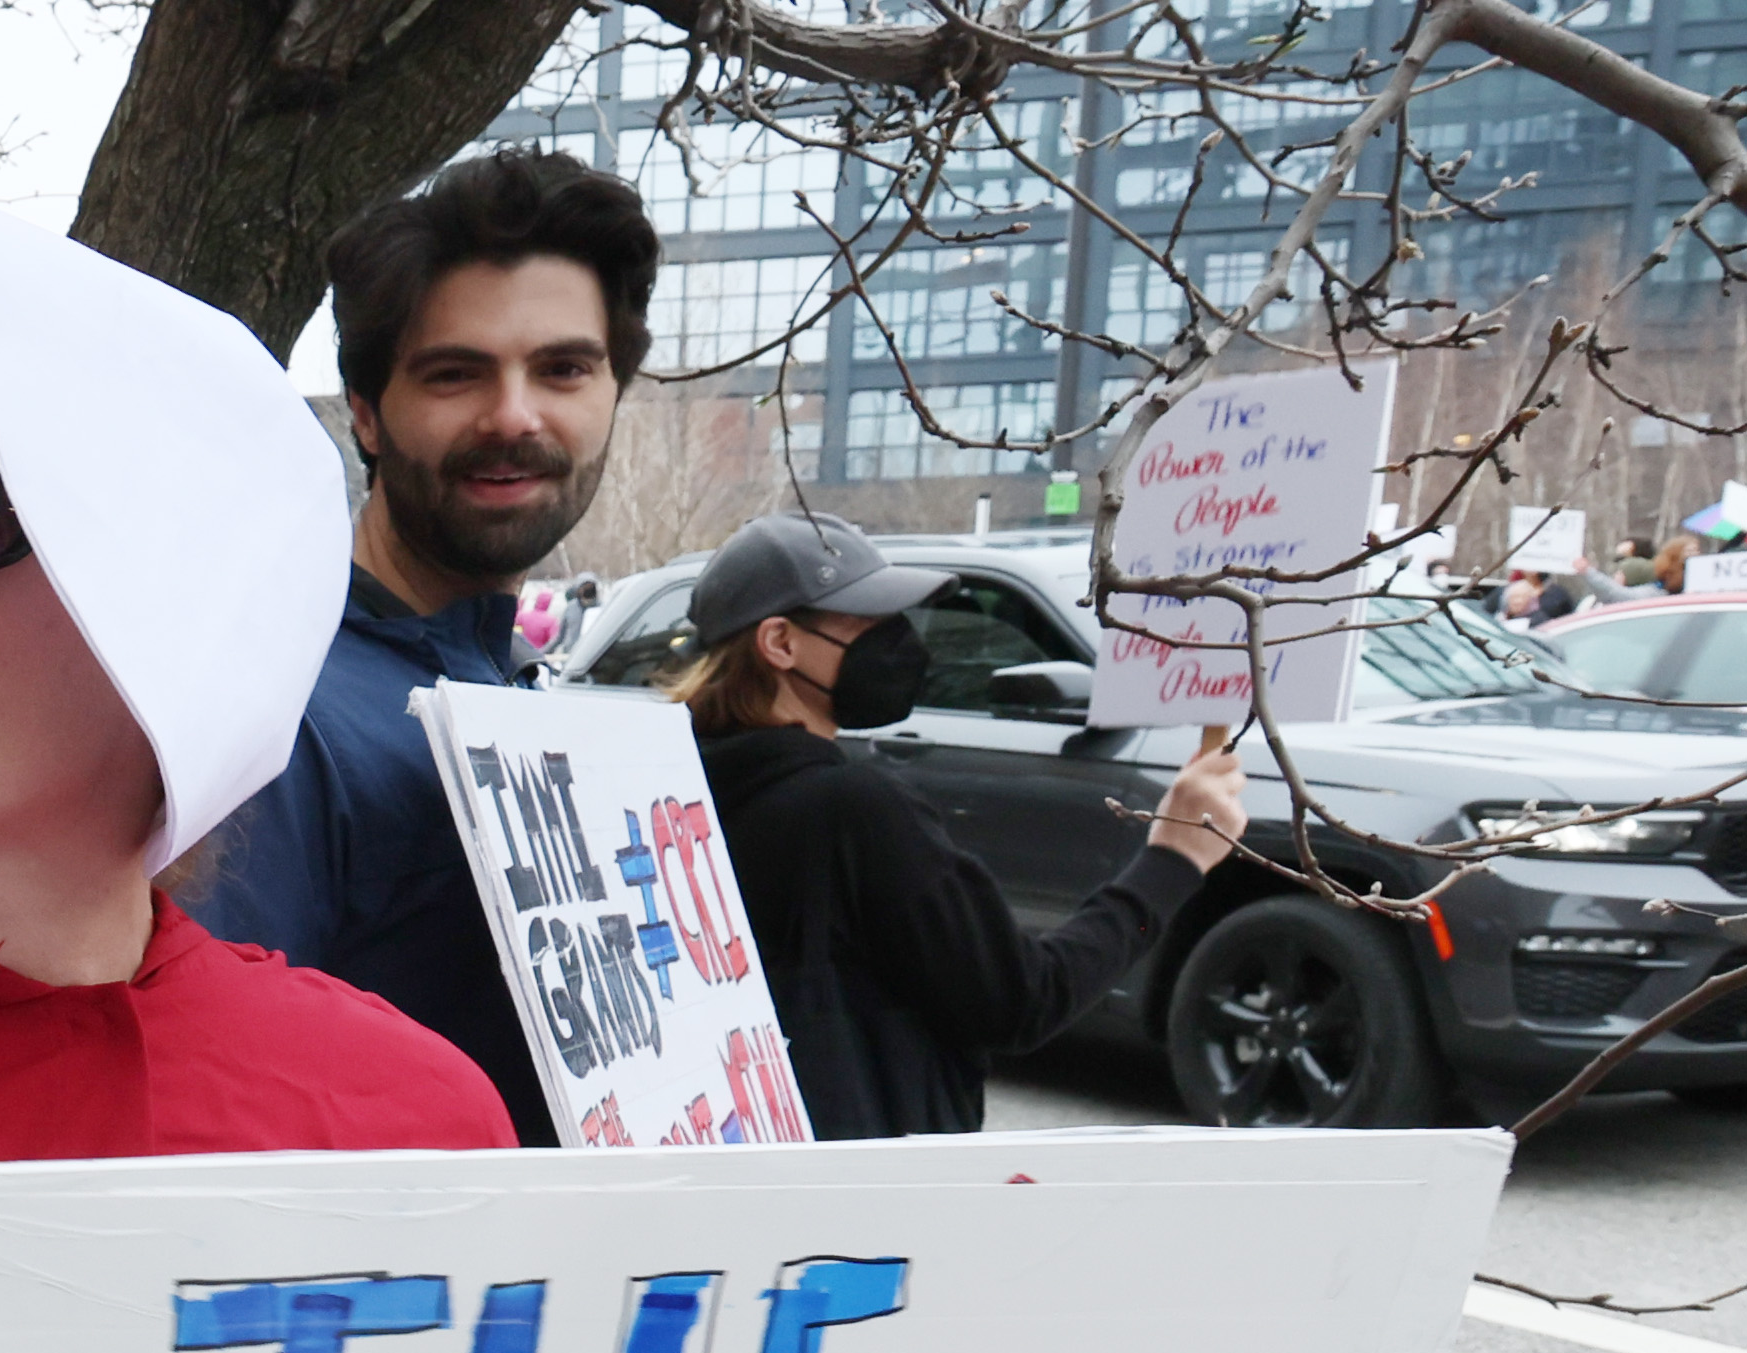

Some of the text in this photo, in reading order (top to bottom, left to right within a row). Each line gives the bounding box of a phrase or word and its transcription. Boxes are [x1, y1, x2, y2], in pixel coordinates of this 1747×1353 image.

[1197, 393, 1265, 433] The
[1139, 433, 1327, 488] Power of the
[1174, 483, 1280, 536] People
[651, 795, 751, 987] CRI
